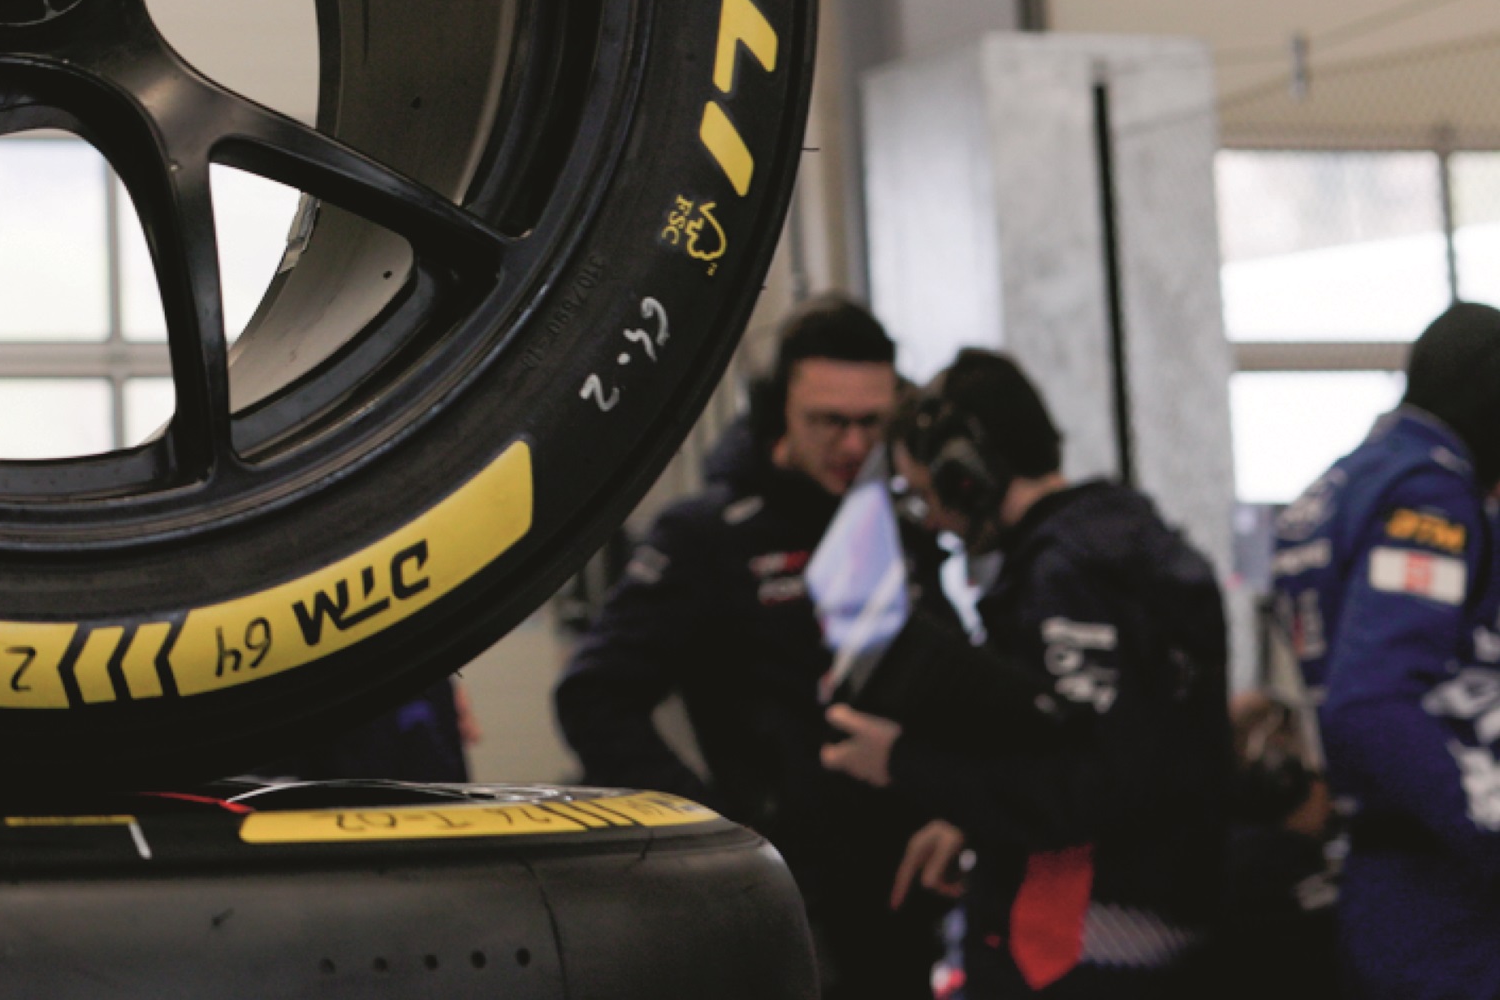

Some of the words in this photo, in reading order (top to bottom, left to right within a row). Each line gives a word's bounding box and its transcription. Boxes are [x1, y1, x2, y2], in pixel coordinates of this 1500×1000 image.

[661, 194, 694, 245] FSC
[293, 539, 431, 646] DTM
[215, 616, 274, 679] 64
